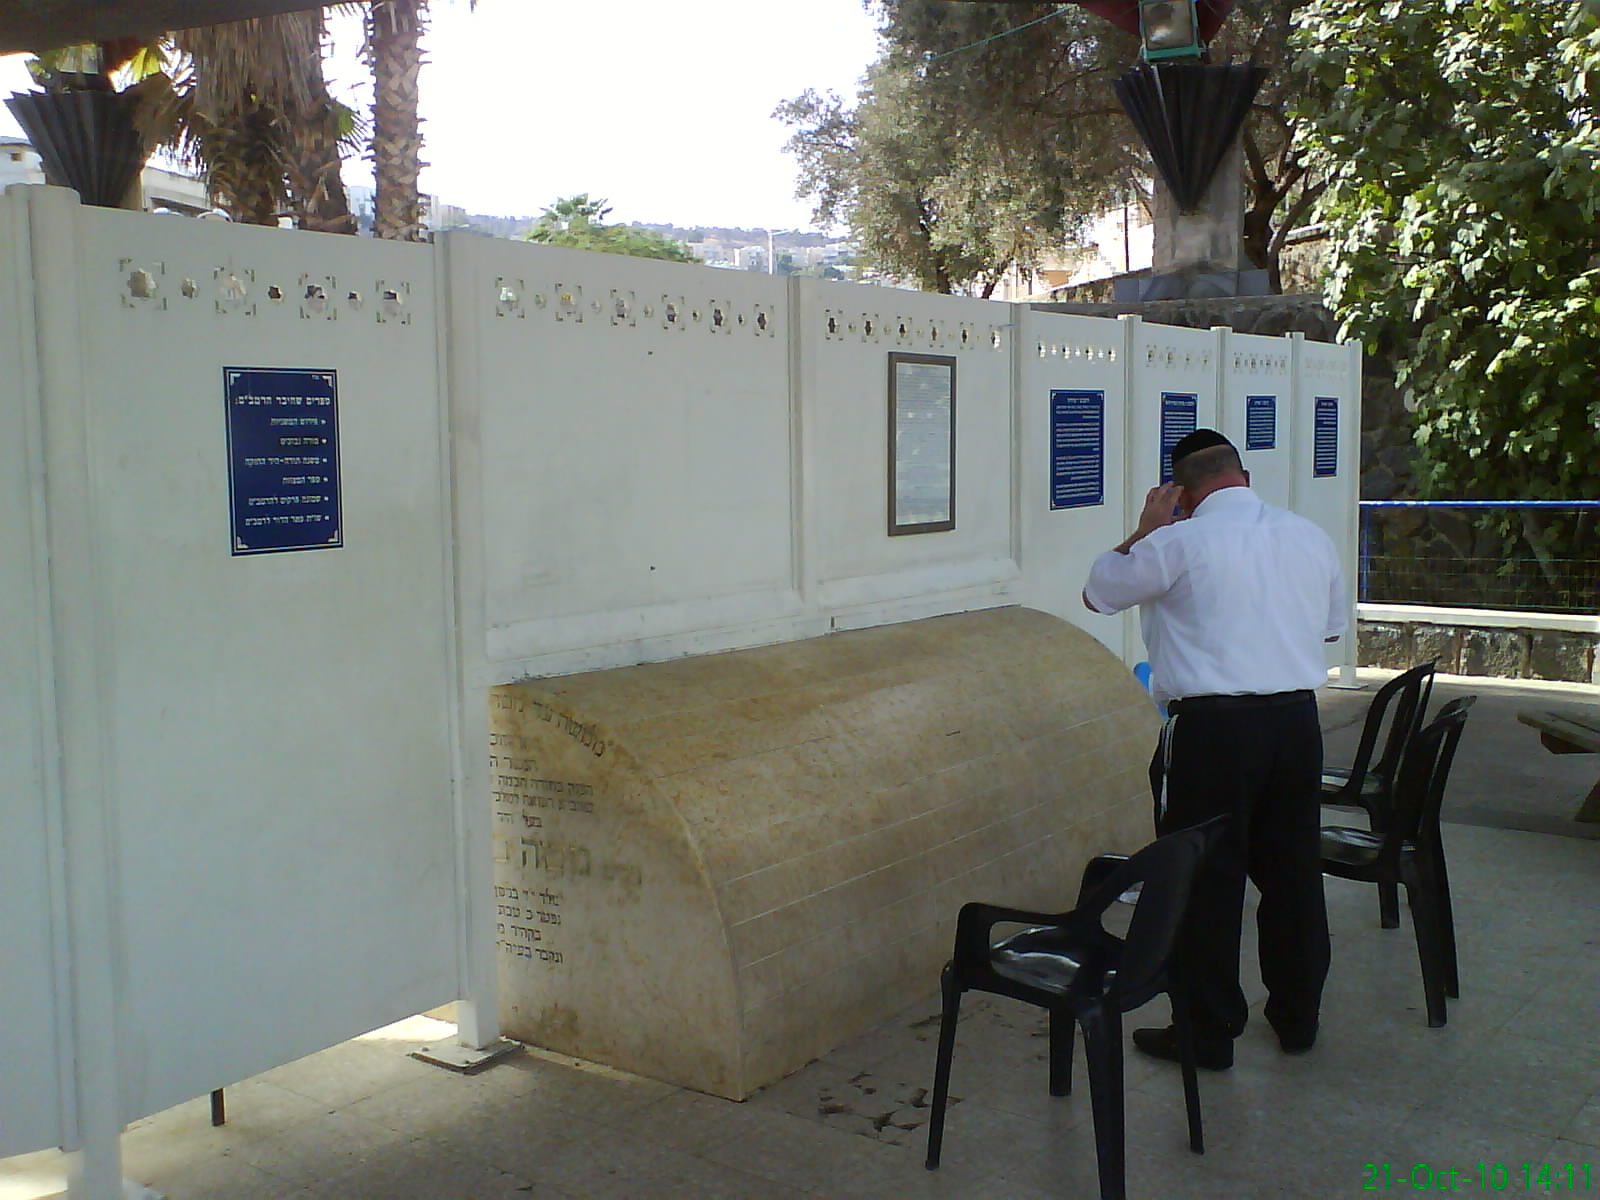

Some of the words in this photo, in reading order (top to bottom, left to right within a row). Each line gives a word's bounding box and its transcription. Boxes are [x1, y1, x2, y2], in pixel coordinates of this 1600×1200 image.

[276, 396, 303, 406] שחיבר
[305, 396, 331, 405] ספרים
[306, 475, 321, 484] ספר
